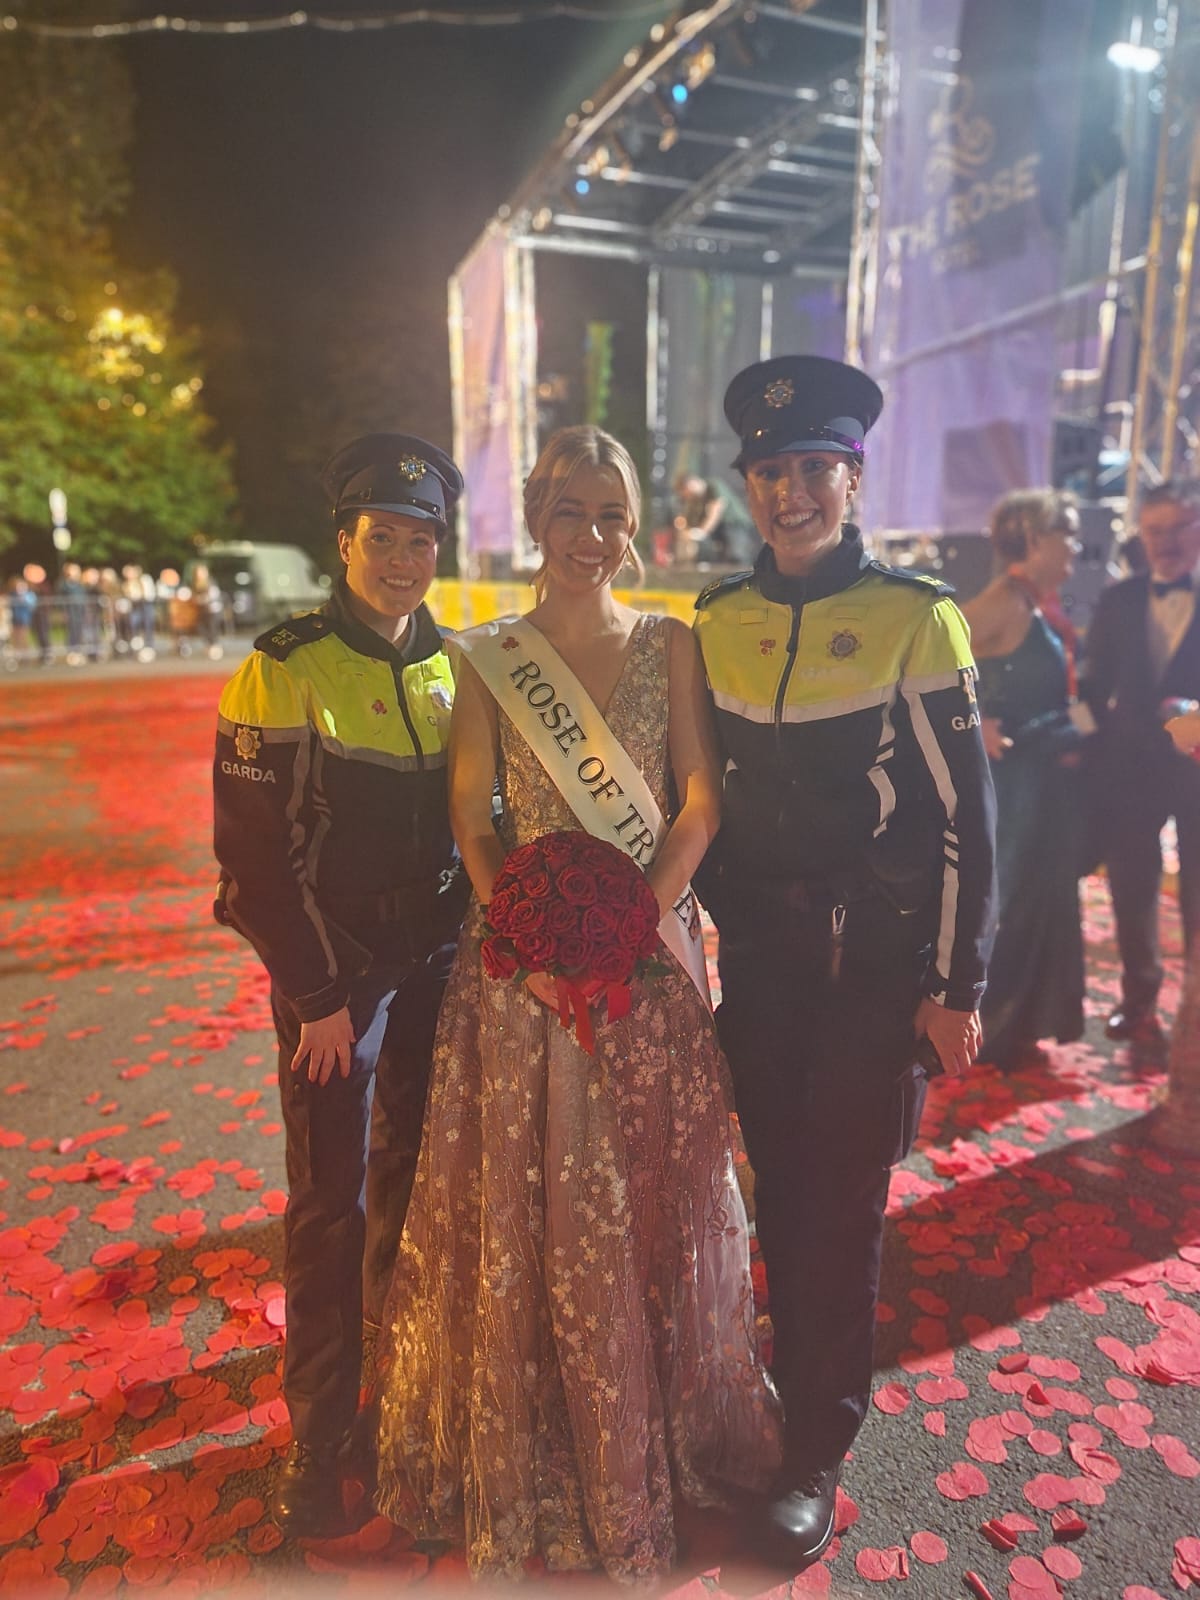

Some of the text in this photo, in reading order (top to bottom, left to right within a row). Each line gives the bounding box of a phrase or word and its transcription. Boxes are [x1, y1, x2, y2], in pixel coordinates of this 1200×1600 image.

[944, 150, 1042, 236] ROSE
[509, 659, 587, 759] ROSE
[576, 756, 626, 806] OF
[951, 711, 981, 731] GA
[221, 760, 277, 784] GARDA
